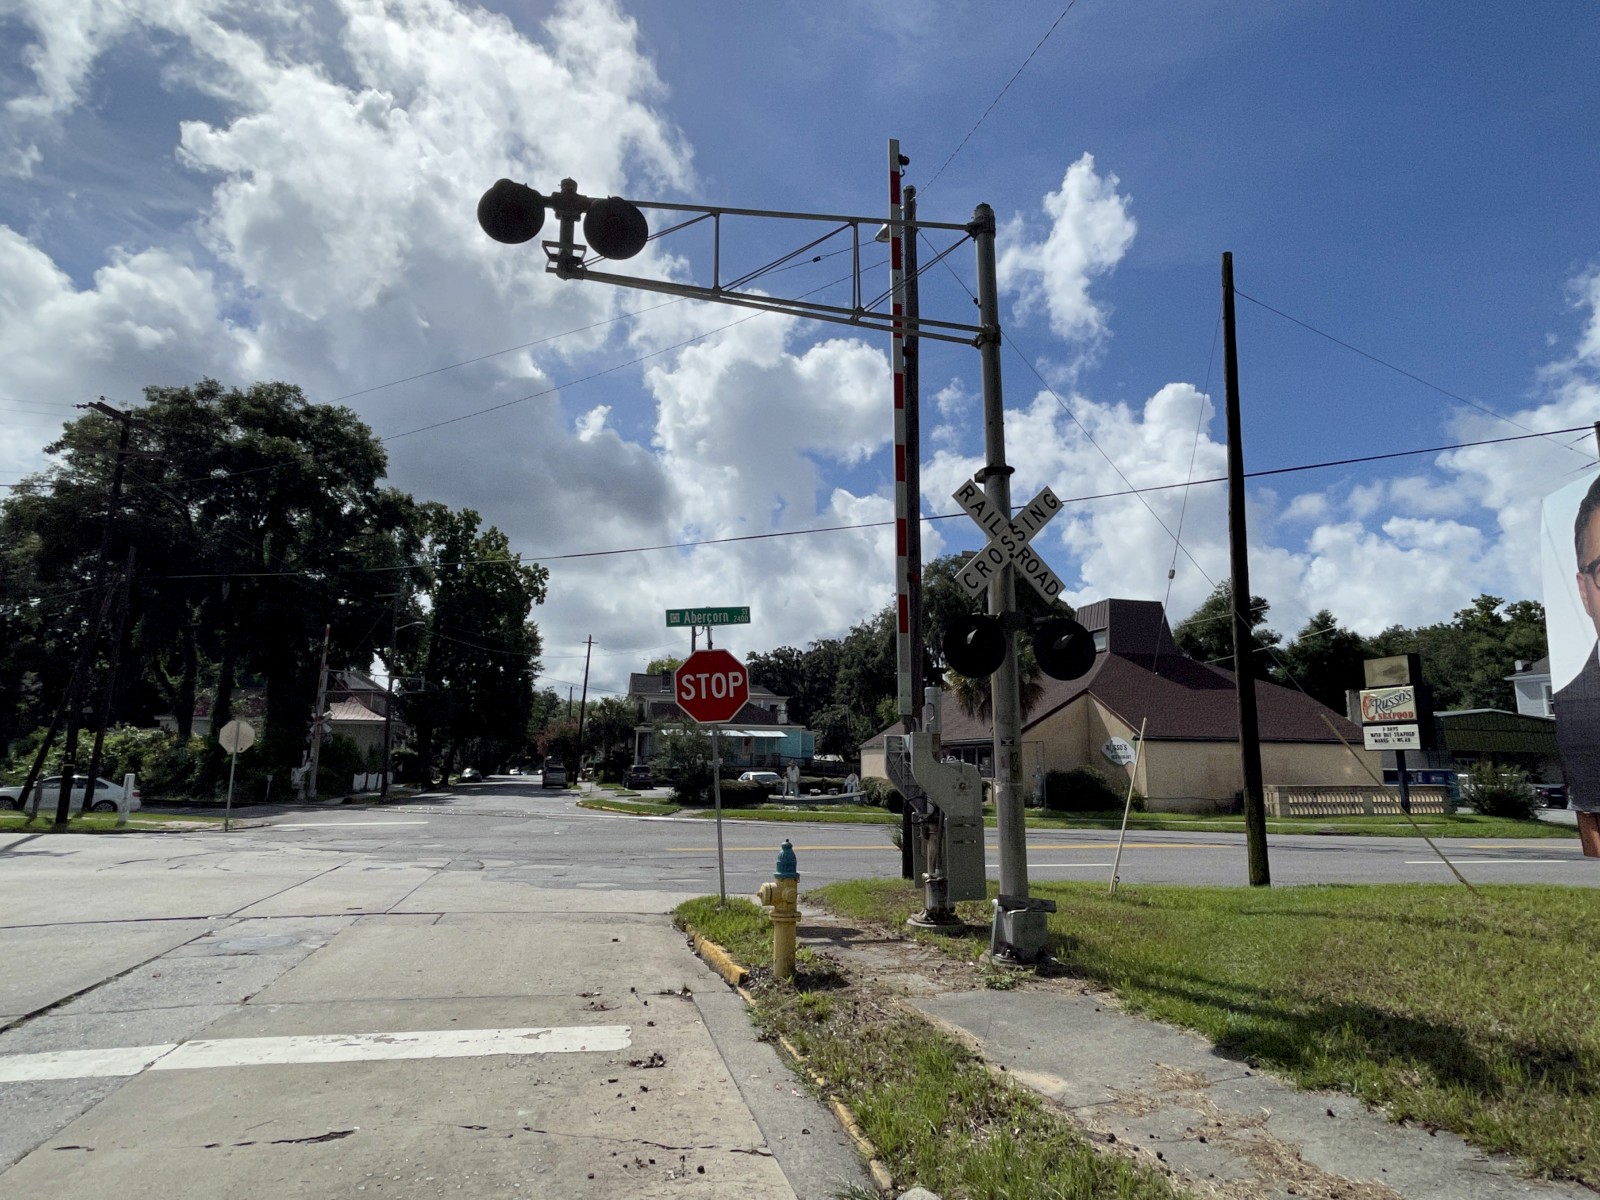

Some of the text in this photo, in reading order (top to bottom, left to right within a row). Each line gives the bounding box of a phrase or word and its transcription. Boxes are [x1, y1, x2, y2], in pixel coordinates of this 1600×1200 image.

[959, 484, 1059, 596] RAIL ROAD
[963, 494, 1058, 590] CROSSING
[684, 610, 728, 624] Abercorn
[680, 672, 744, 700] STOP
